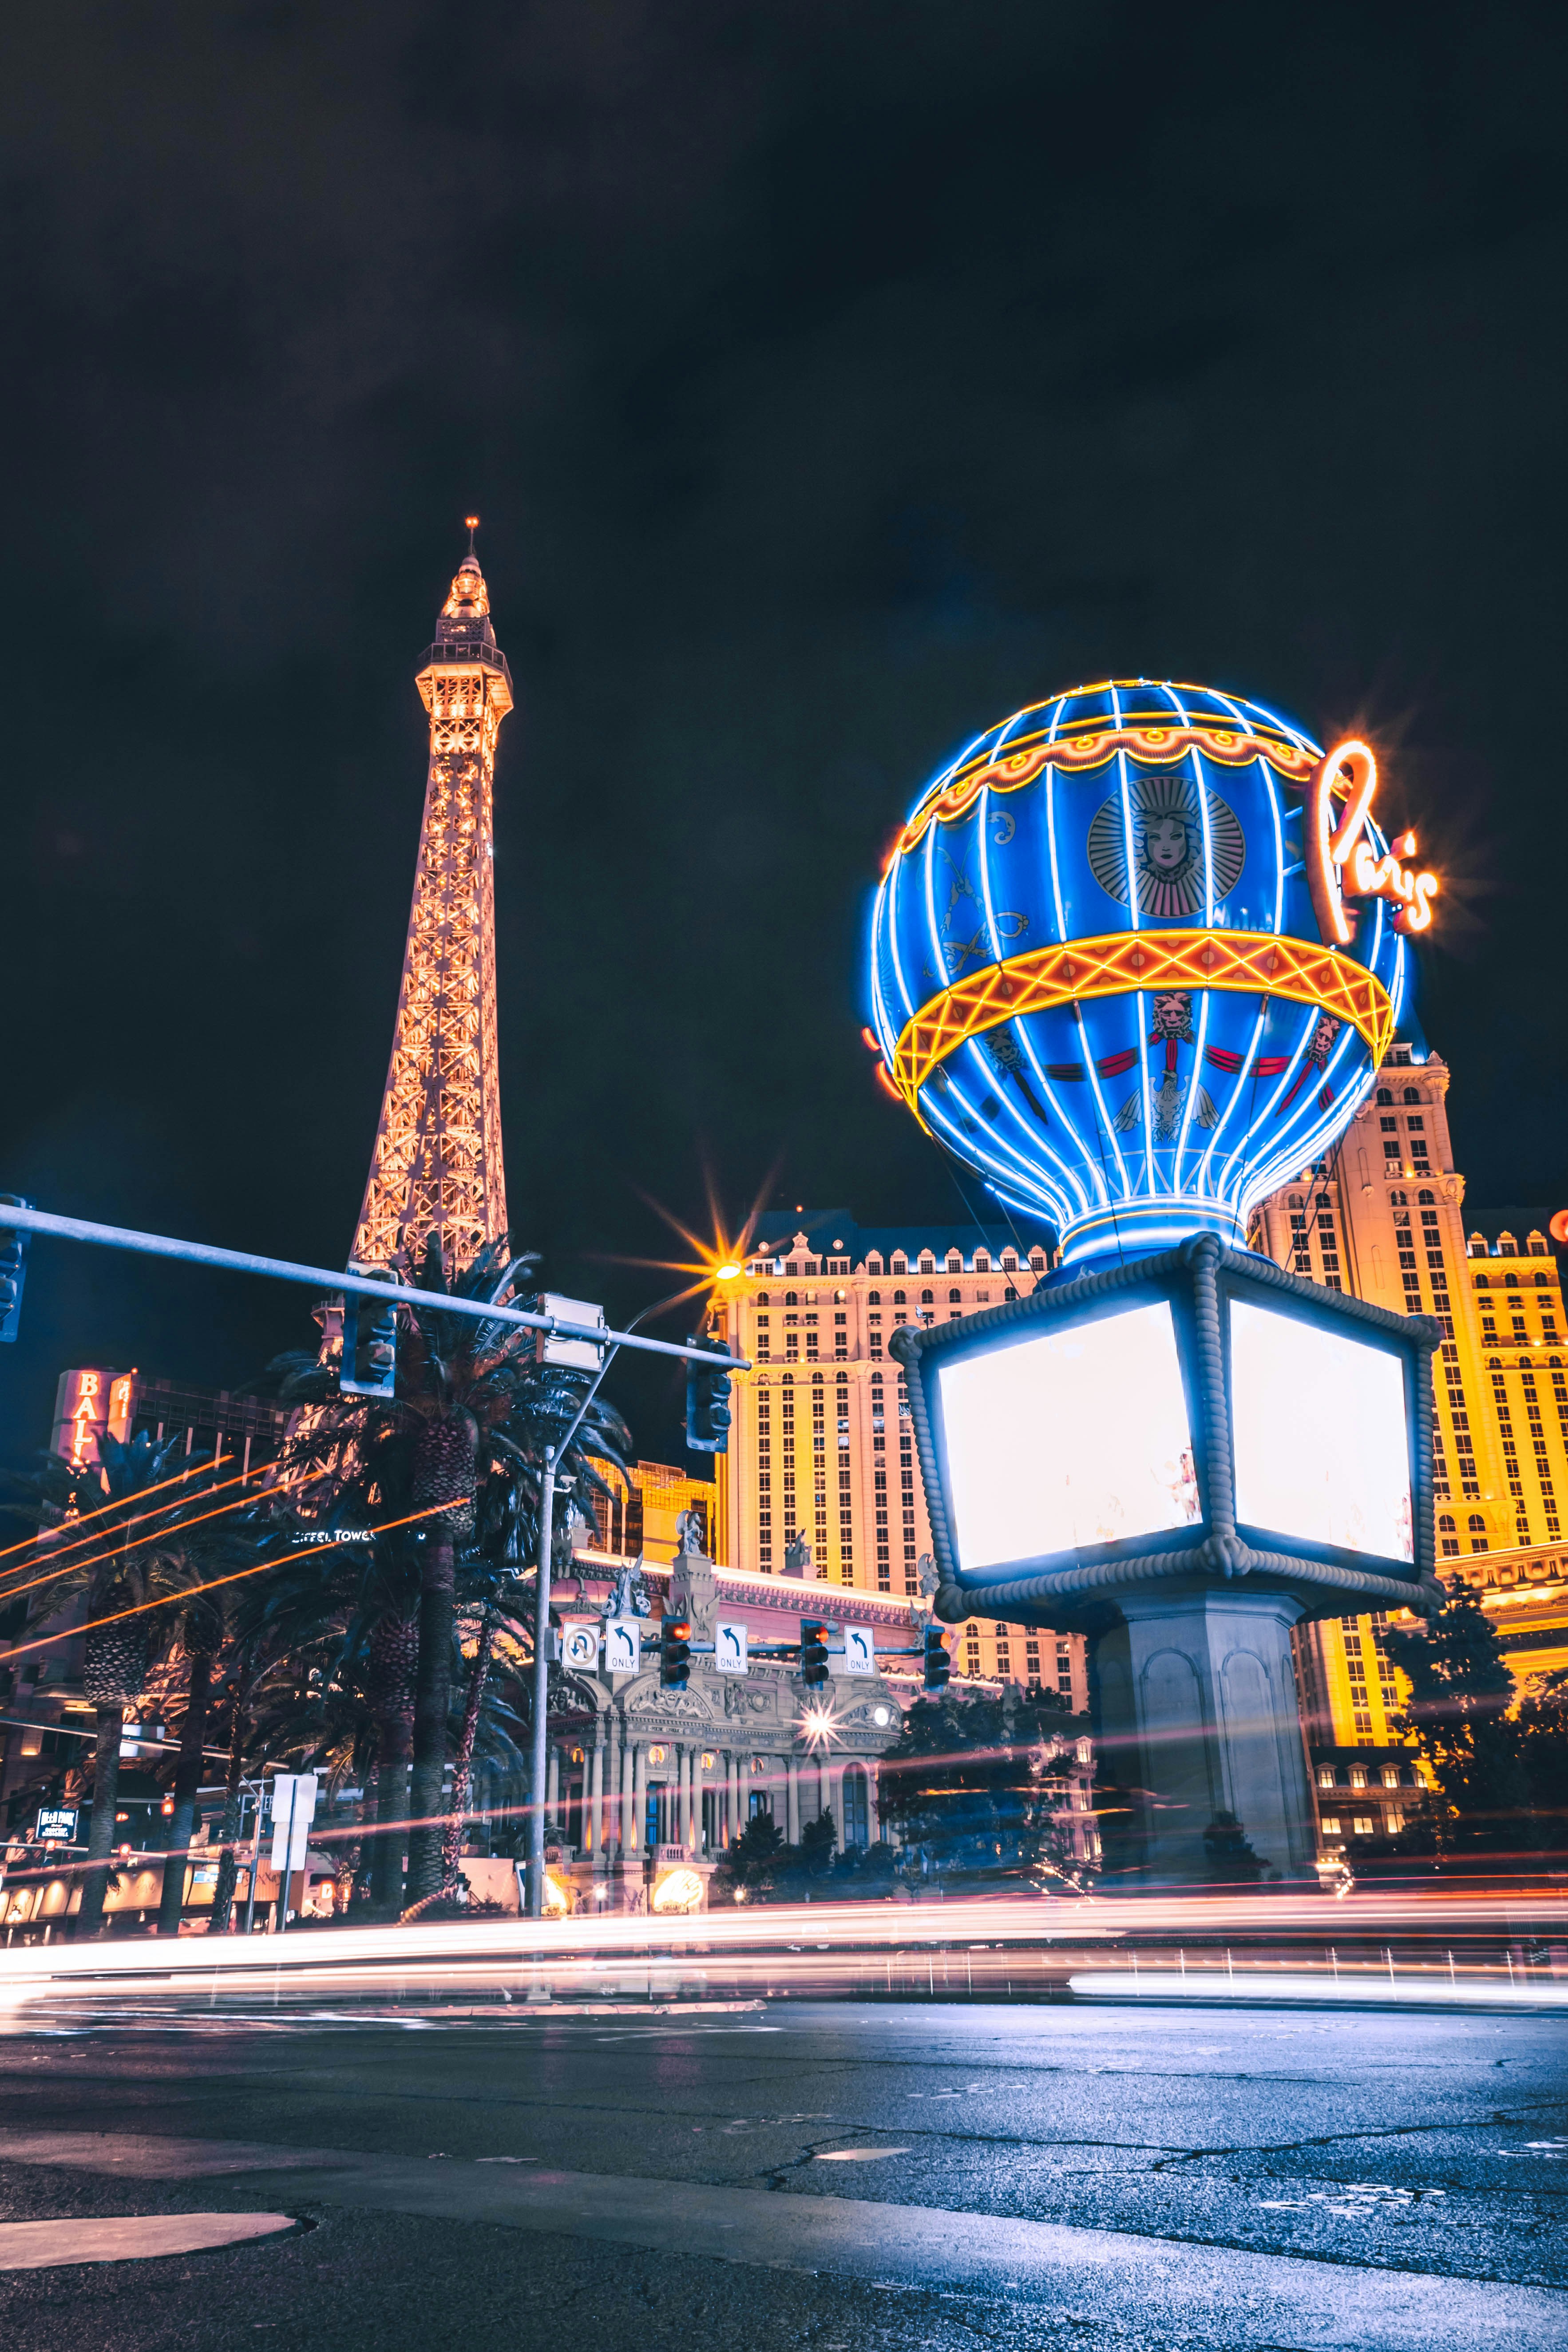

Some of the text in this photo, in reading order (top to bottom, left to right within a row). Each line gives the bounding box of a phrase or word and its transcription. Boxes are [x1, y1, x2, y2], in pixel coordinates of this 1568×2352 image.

[1316, 739, 1438, 942] Paris
[612, 1657, 635, 1668] ONLY
[721, 1658, 742, 1668] ONLY
[851, 1660, 870, 1670] ONLY
